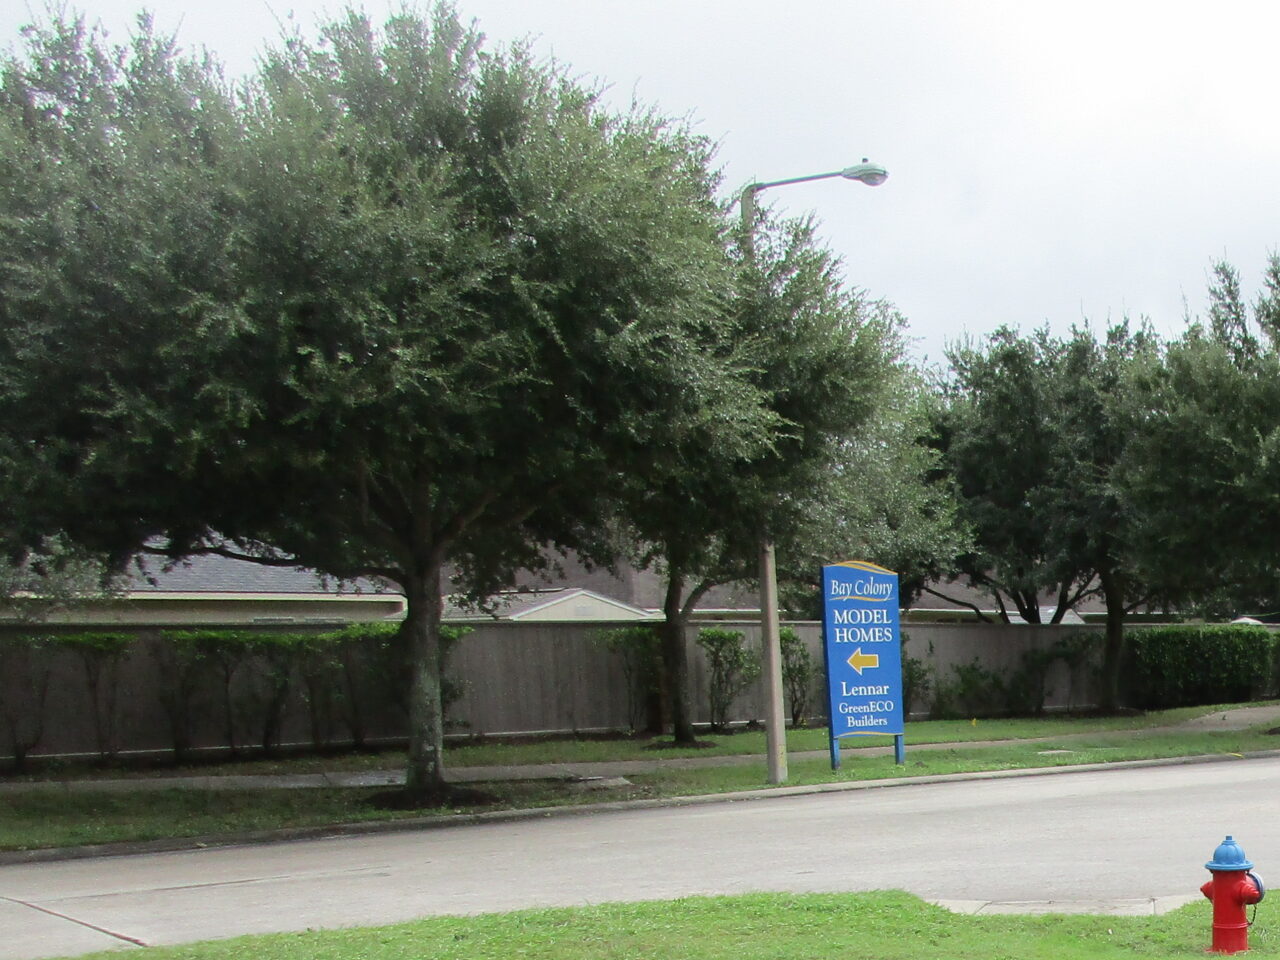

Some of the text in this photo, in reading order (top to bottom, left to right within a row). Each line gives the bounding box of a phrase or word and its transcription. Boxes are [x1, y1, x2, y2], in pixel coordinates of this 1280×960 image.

[831, 576, 893, 601] Bay Colony
[834, 609, 892, 624] MODEL
[835, 627, 893, 643] HOMES
[841, 681, 889, 697] Lennar
[839, 701, 894, 714] GreenECO
[847, 715, 888, 728] Builders
